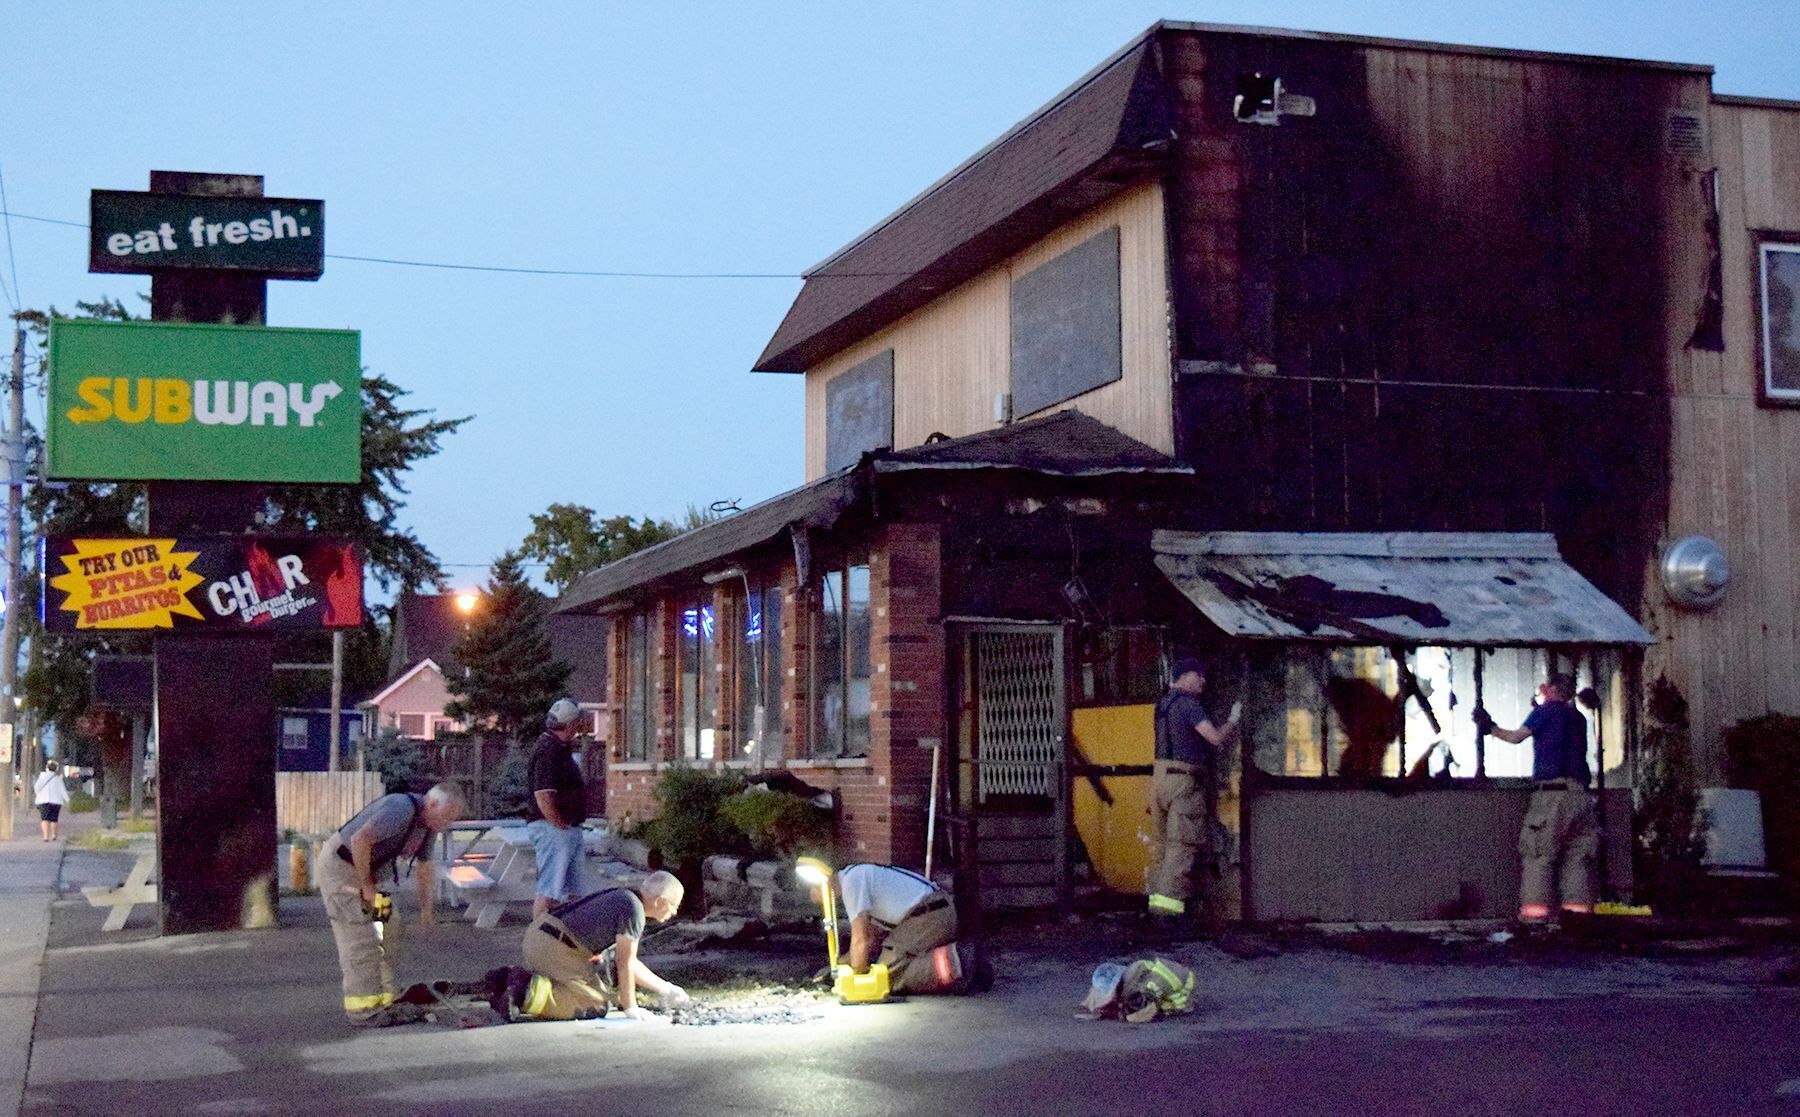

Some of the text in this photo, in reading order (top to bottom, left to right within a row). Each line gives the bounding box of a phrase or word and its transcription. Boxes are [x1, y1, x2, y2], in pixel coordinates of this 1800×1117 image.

[107, 209, 312, 257] eat fresh.
[66, 376, 344, 428] SUBWAY
[79, 544, 160, 577] TRY OUR
[88, 563, 183, 600] PITAS &
[83, 586, 182, 625] BURRITOS
[241, 588, 295, 624] gourmet
